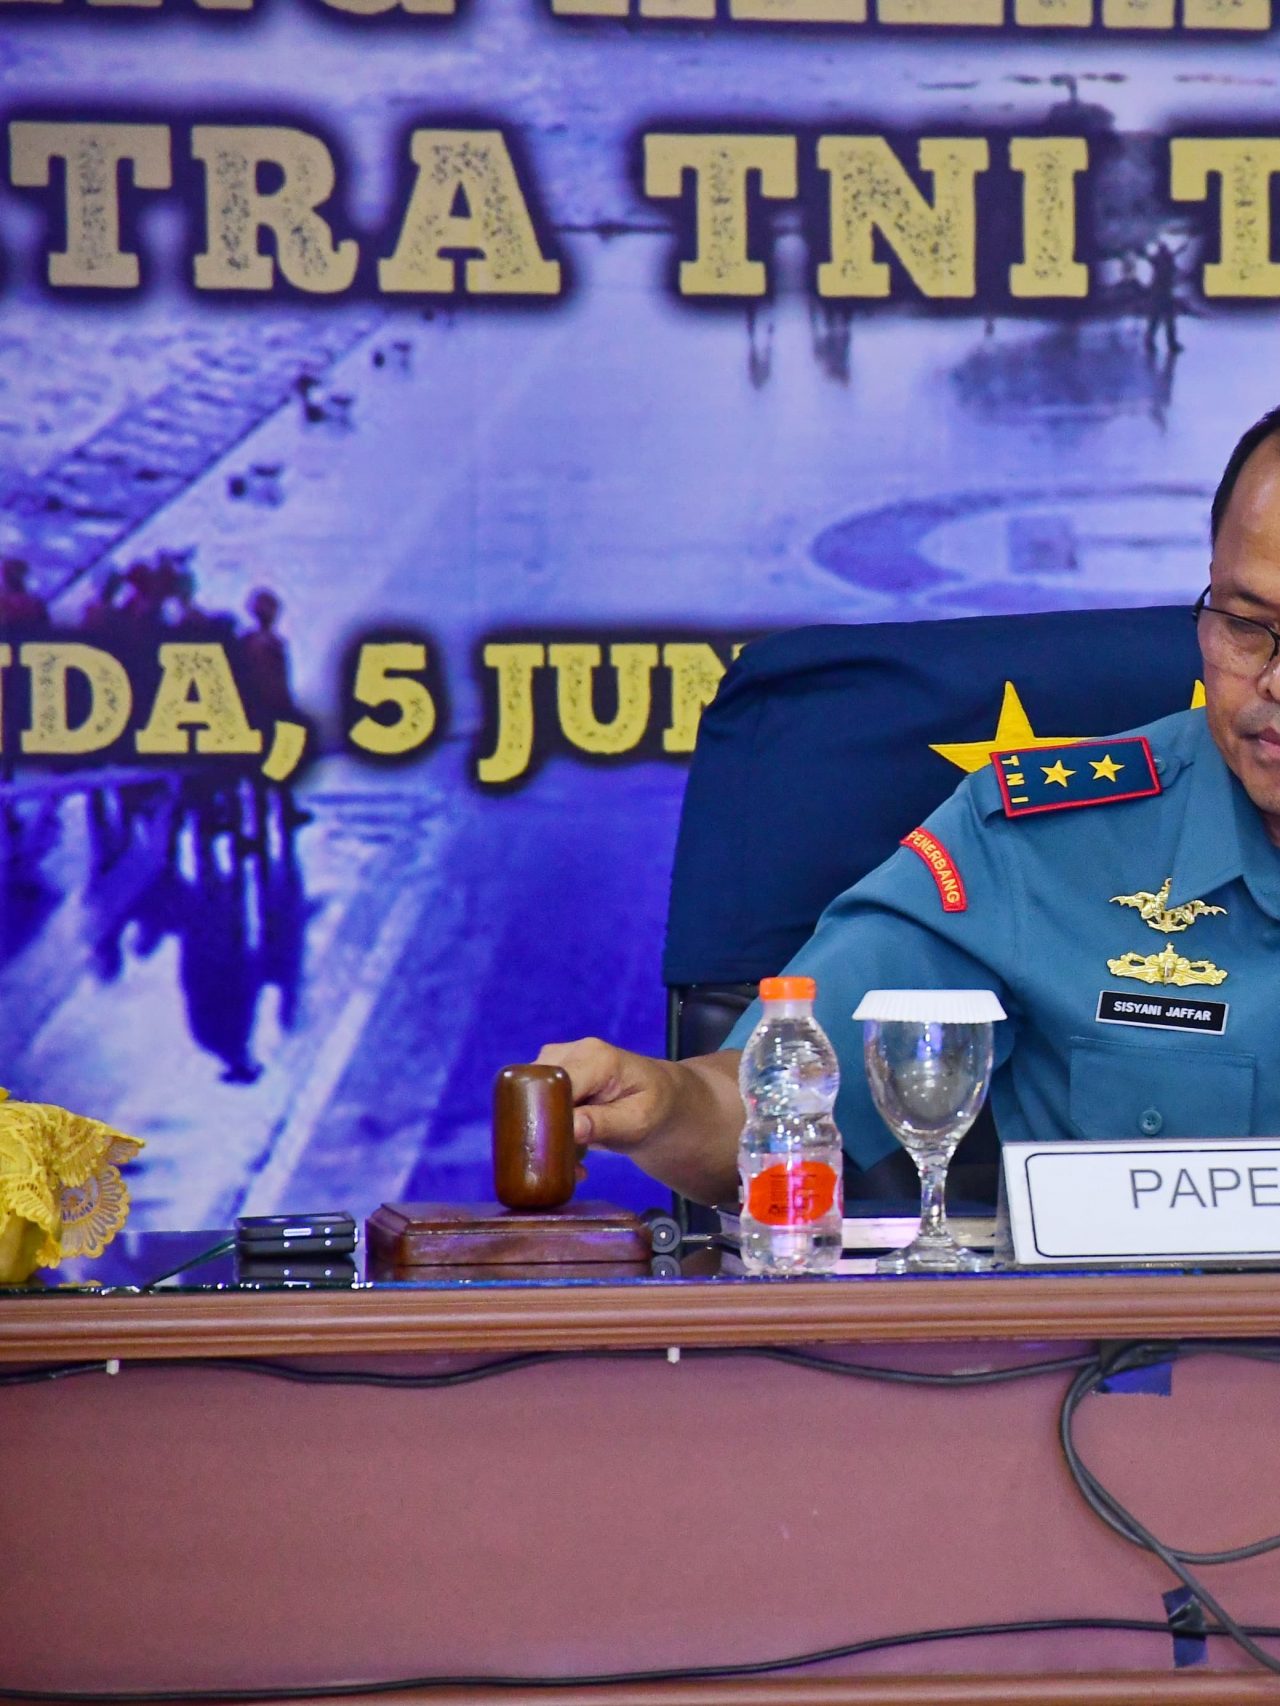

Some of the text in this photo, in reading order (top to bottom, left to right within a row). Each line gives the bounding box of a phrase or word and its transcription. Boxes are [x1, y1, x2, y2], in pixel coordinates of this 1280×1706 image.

[8, 121, 560, 293] TRA
[644, 134, 1089, 297] TNI
[0, 643, 306, 781] DA,
[349, 643, 436, 754] 5
[1001, 755, 1029, 803] TNI
[906, 831, 960, 903] PENERBANG
[1113, 1001, 1212, 1021] SISYANI JAFFAR
